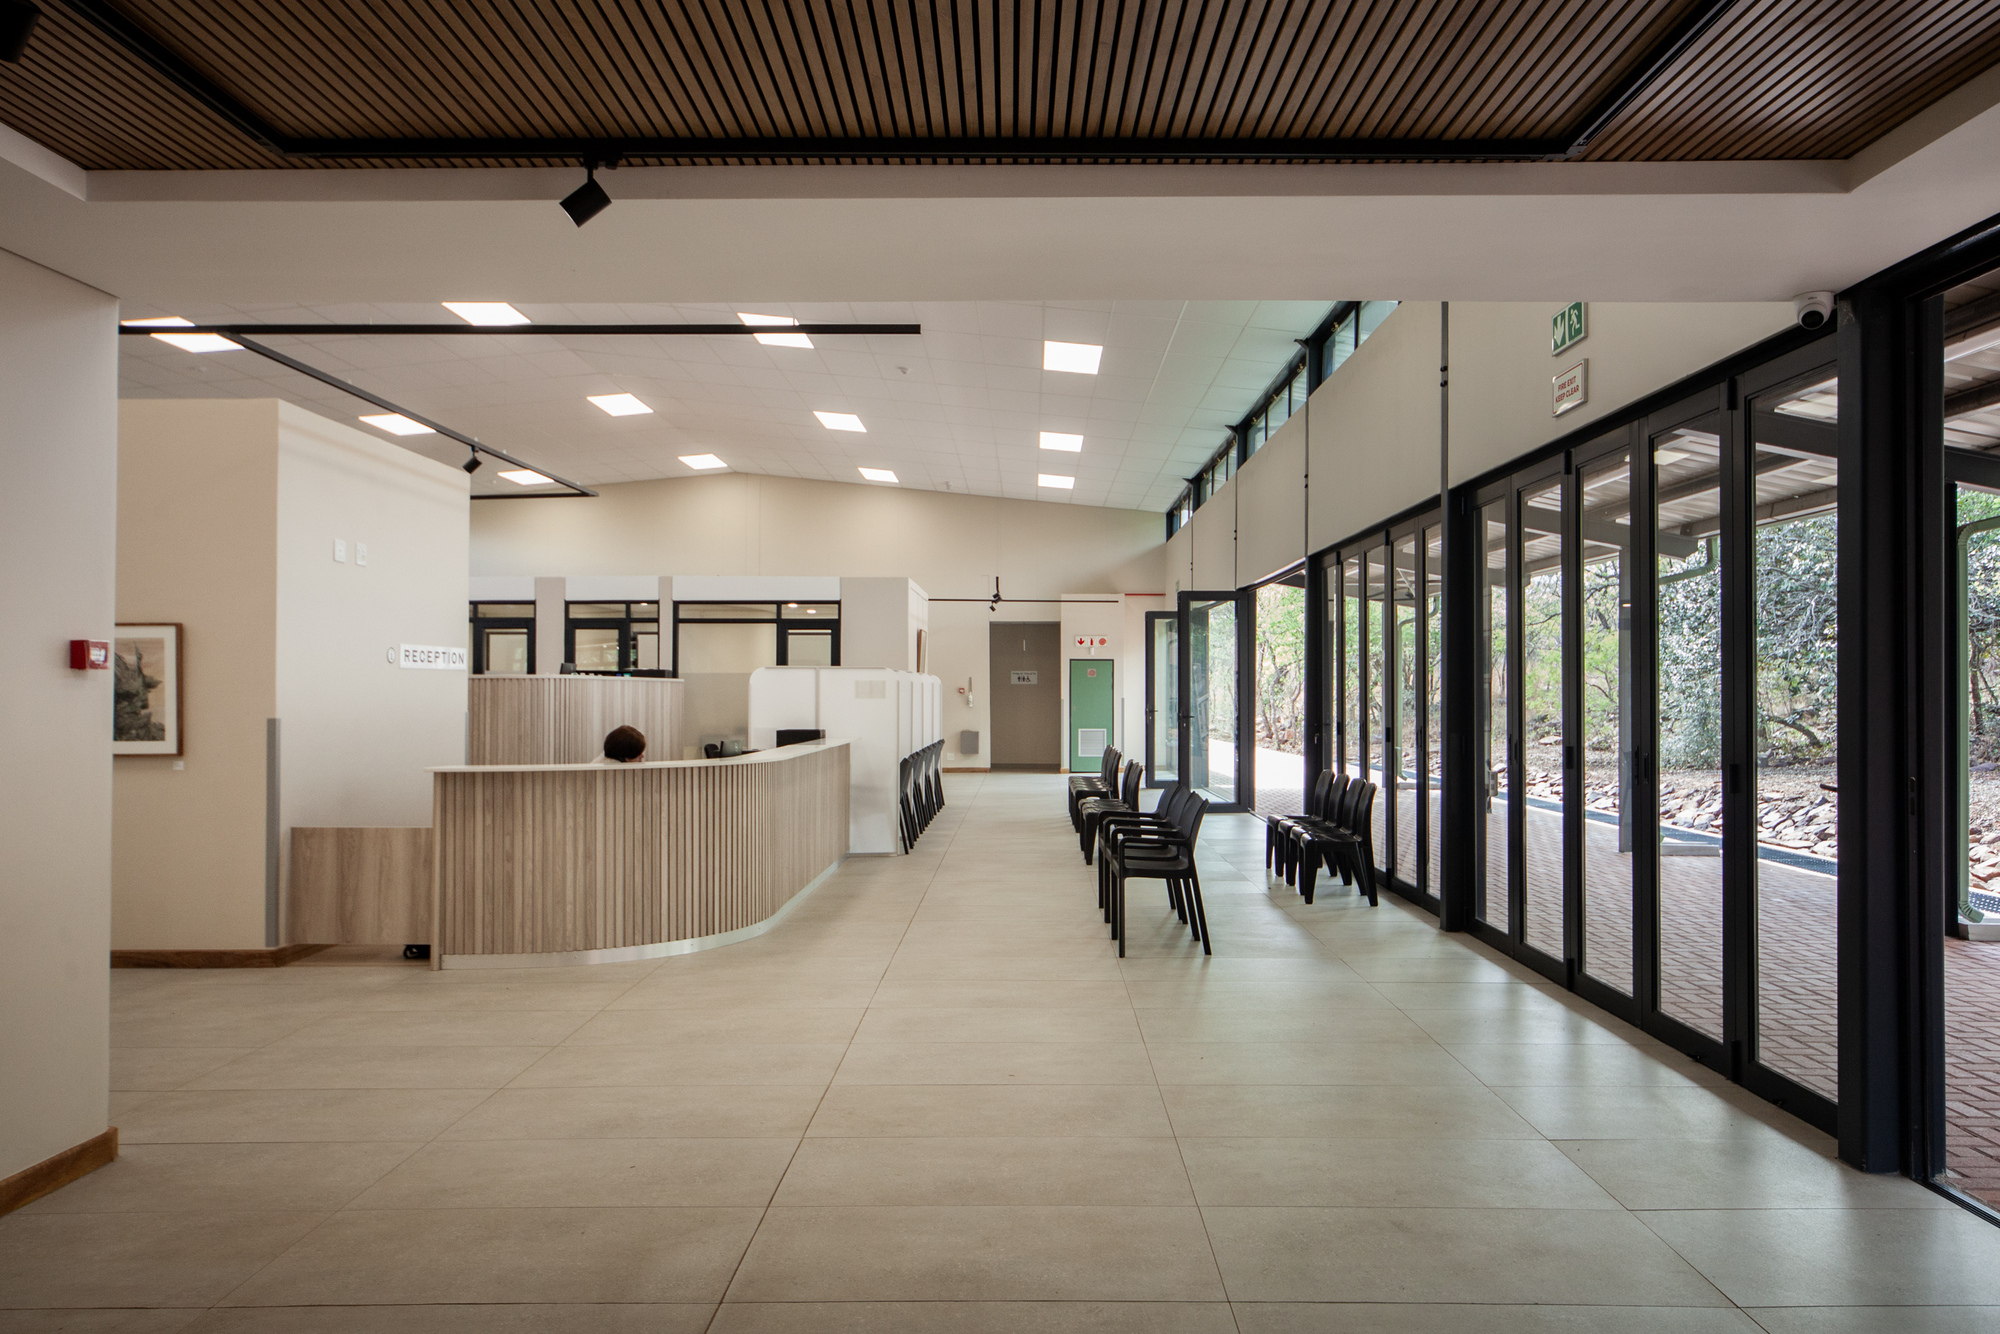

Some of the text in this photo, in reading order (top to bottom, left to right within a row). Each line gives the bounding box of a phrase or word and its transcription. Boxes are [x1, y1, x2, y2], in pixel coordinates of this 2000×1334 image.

[1558, 375, 1576, 392] FIRE EXIT
[1555, 384, 1579, 403] KEEP CLEAR
[404, 649, 465, 665] RECEPTION
